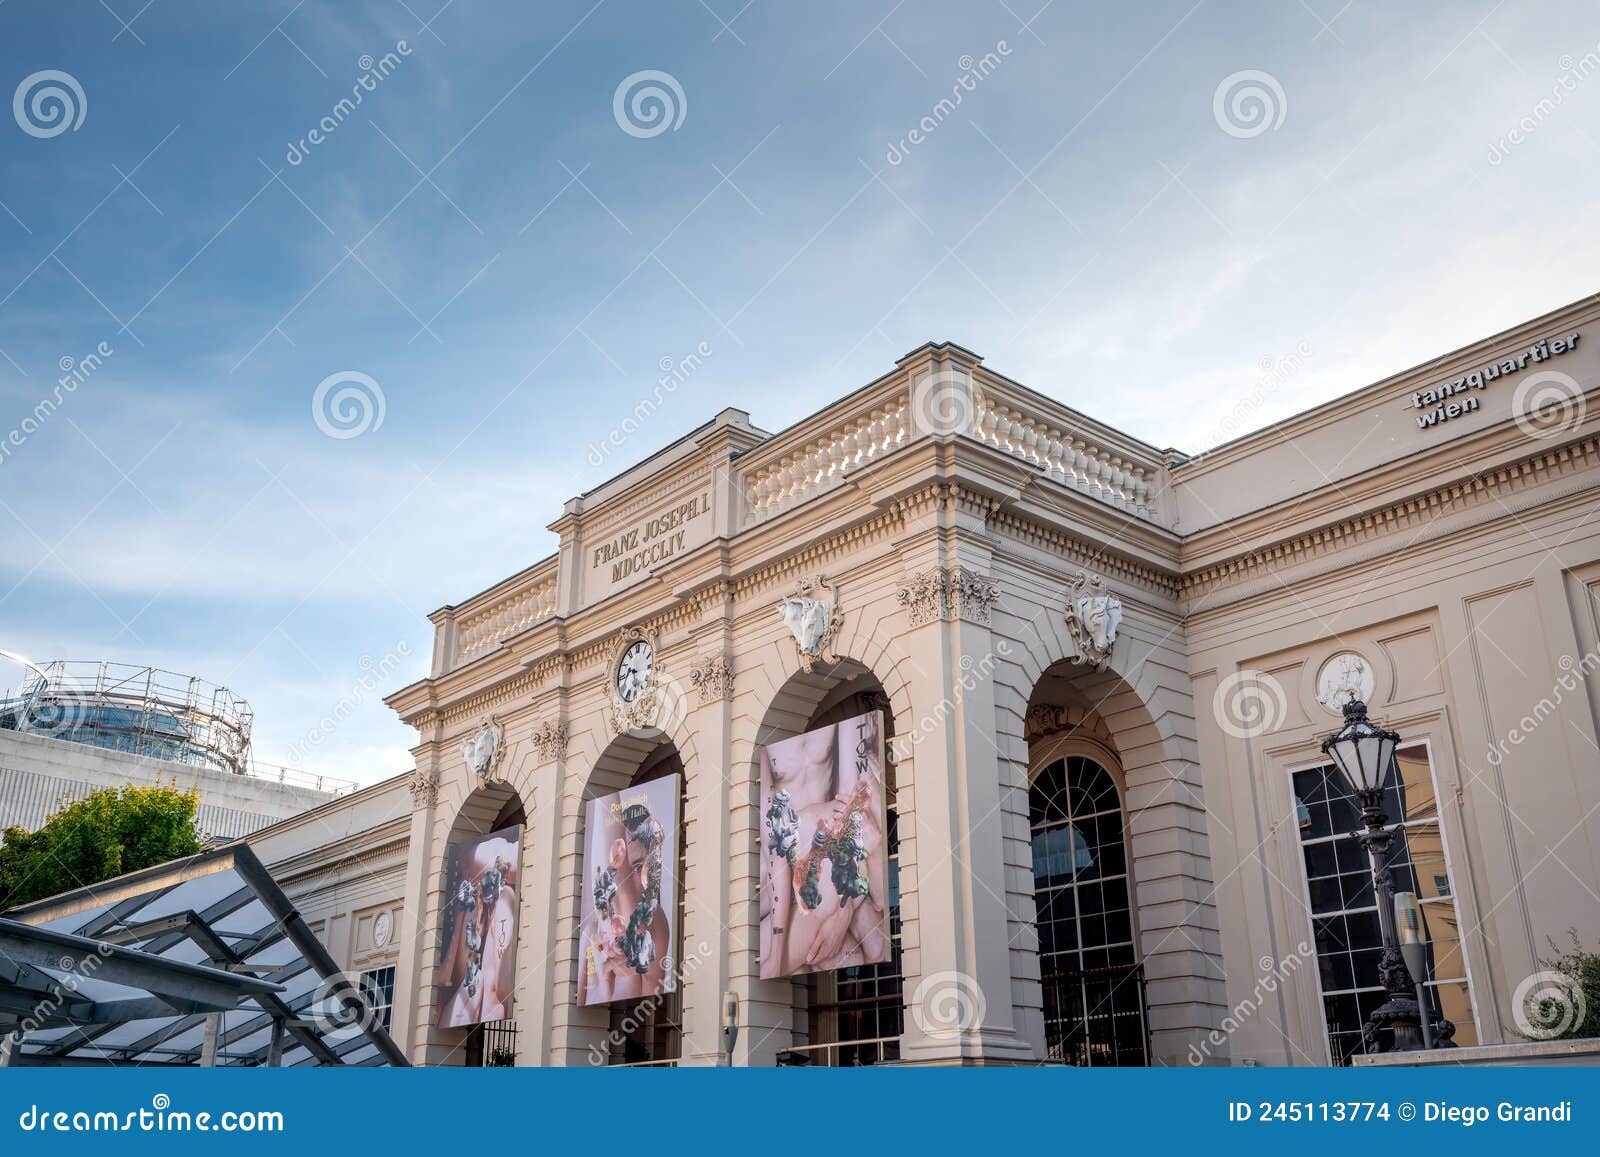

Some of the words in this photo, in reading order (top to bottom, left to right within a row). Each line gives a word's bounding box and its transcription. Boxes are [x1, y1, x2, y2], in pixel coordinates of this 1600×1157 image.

[1411, 332, 1580, 408] tanzquartier
[1415, 395, 1479, 428] wien
[593, 528, 639, 568] FRANZ
